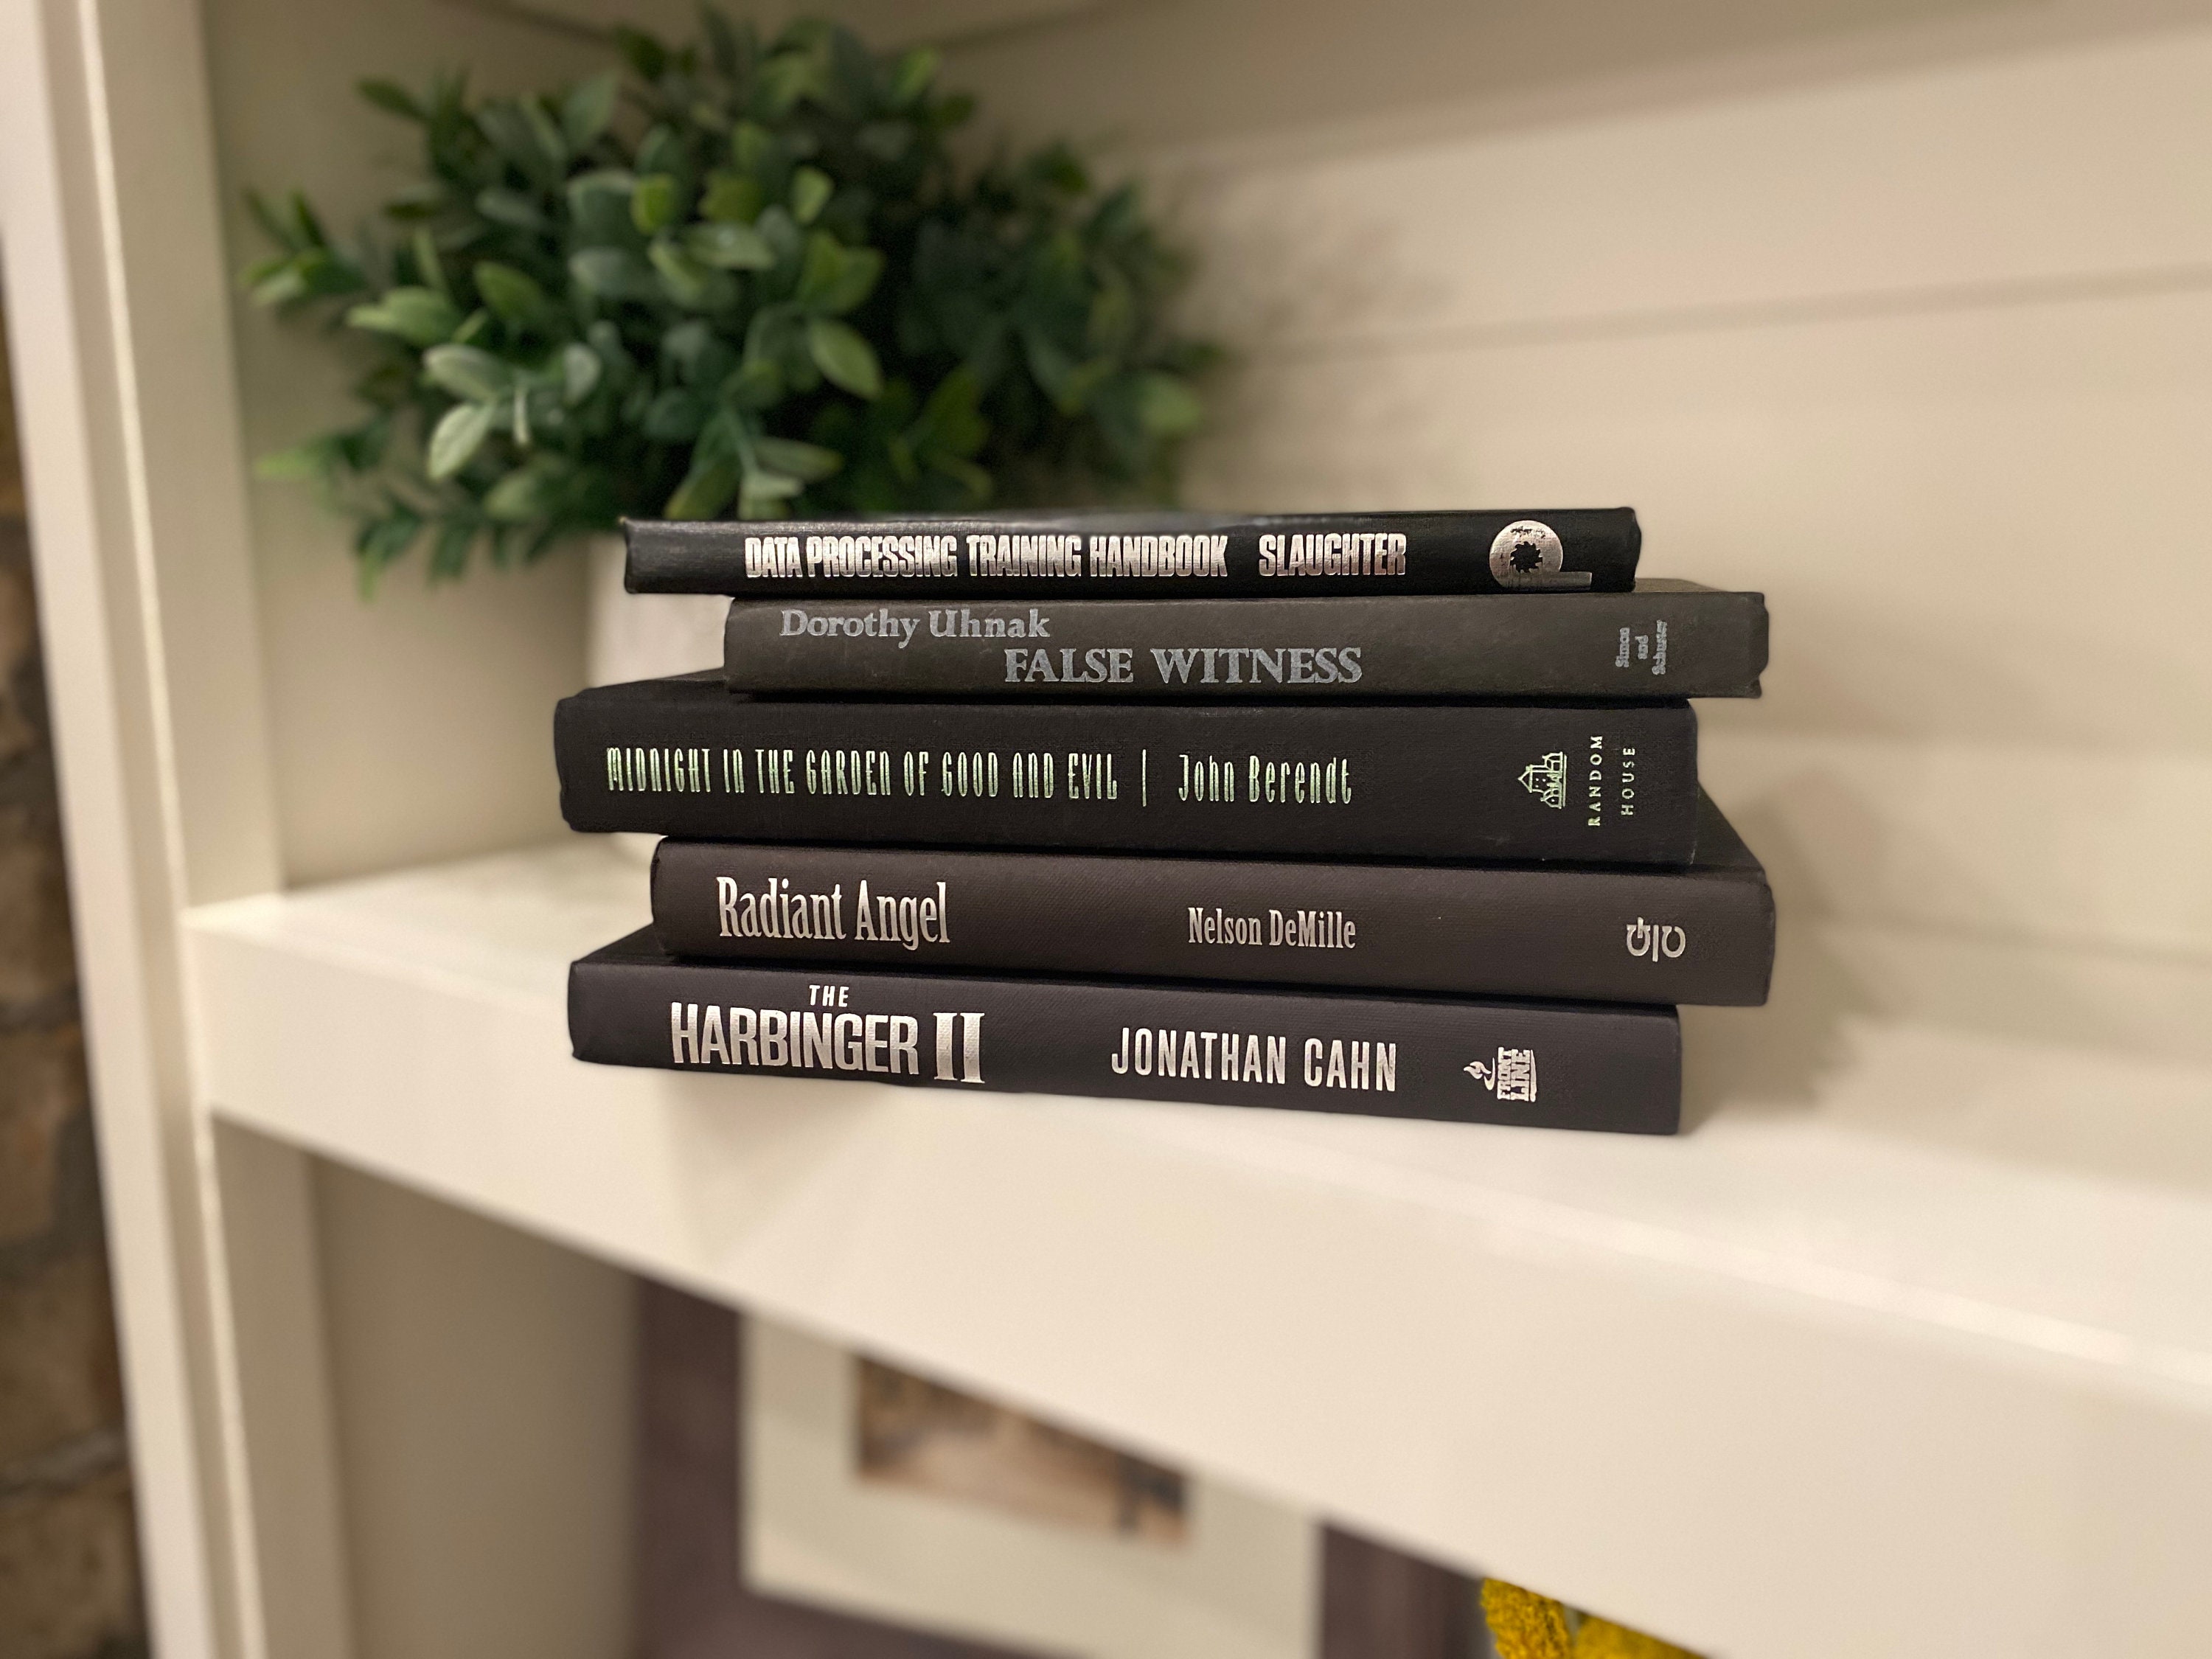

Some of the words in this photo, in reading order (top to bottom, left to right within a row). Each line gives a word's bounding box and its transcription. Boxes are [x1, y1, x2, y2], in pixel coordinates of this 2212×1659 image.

[745, 537, 802, 578] DATA
[807, 536, 958, 577] PROCESSING
[967, 535, 1082, 577] TRAINING
[1089, 535, 1228, 578] HANDBOOK
[1259, 533, 1407, 577] SLAUGHTER
[780, 609, 920, 648] Dorothy
[928, 609, 1050, 638] Uhnak
[1615, 627, 1630, 667] Simon
[1635, 635, 1649, 660] and
[1004, 648, 1133, 684] FALSE
[1150, 647, 1363, 685] WITNESS
[607, 748, 712, 792] MIDNIGHT
[724, 748, 745, 793] IN
[755, 749, 794, 794] THE
[807, 750, 891, 795] GARDEN
[904, 751, 929, 796] OF
[942, 752, 998, 797] GOOD
[1012, 753, 1054, 798] AND
[1068, 754, 1117, 799] EVIL
[1178, 754, 1234, 802] John
[1249, 755, 1352, 804] Berendt
[1587, 736, 1603, 827] RANDOM
[1621, 747, 1635, 816] HOUSE
[716, 876, 846, 940] Radiant
[855, 880, 950, 950] Angel
[1188, 907, 1262, 946] Nelson
[1269, 909, 1356, 950] DeMille
[809, 985, 849, 1008] THE
[671, 1002, 919, 1075] HARBINGER
[933, 1012, 986, 1084] II
[1110, 1027, 1287, 1085] JONATHAN
[1304, 1037, 1397, 1092] CAHN
[1497, 1047, 1511, 1100] FRONT
[1511, 1048, 1531, 1102] LINE
